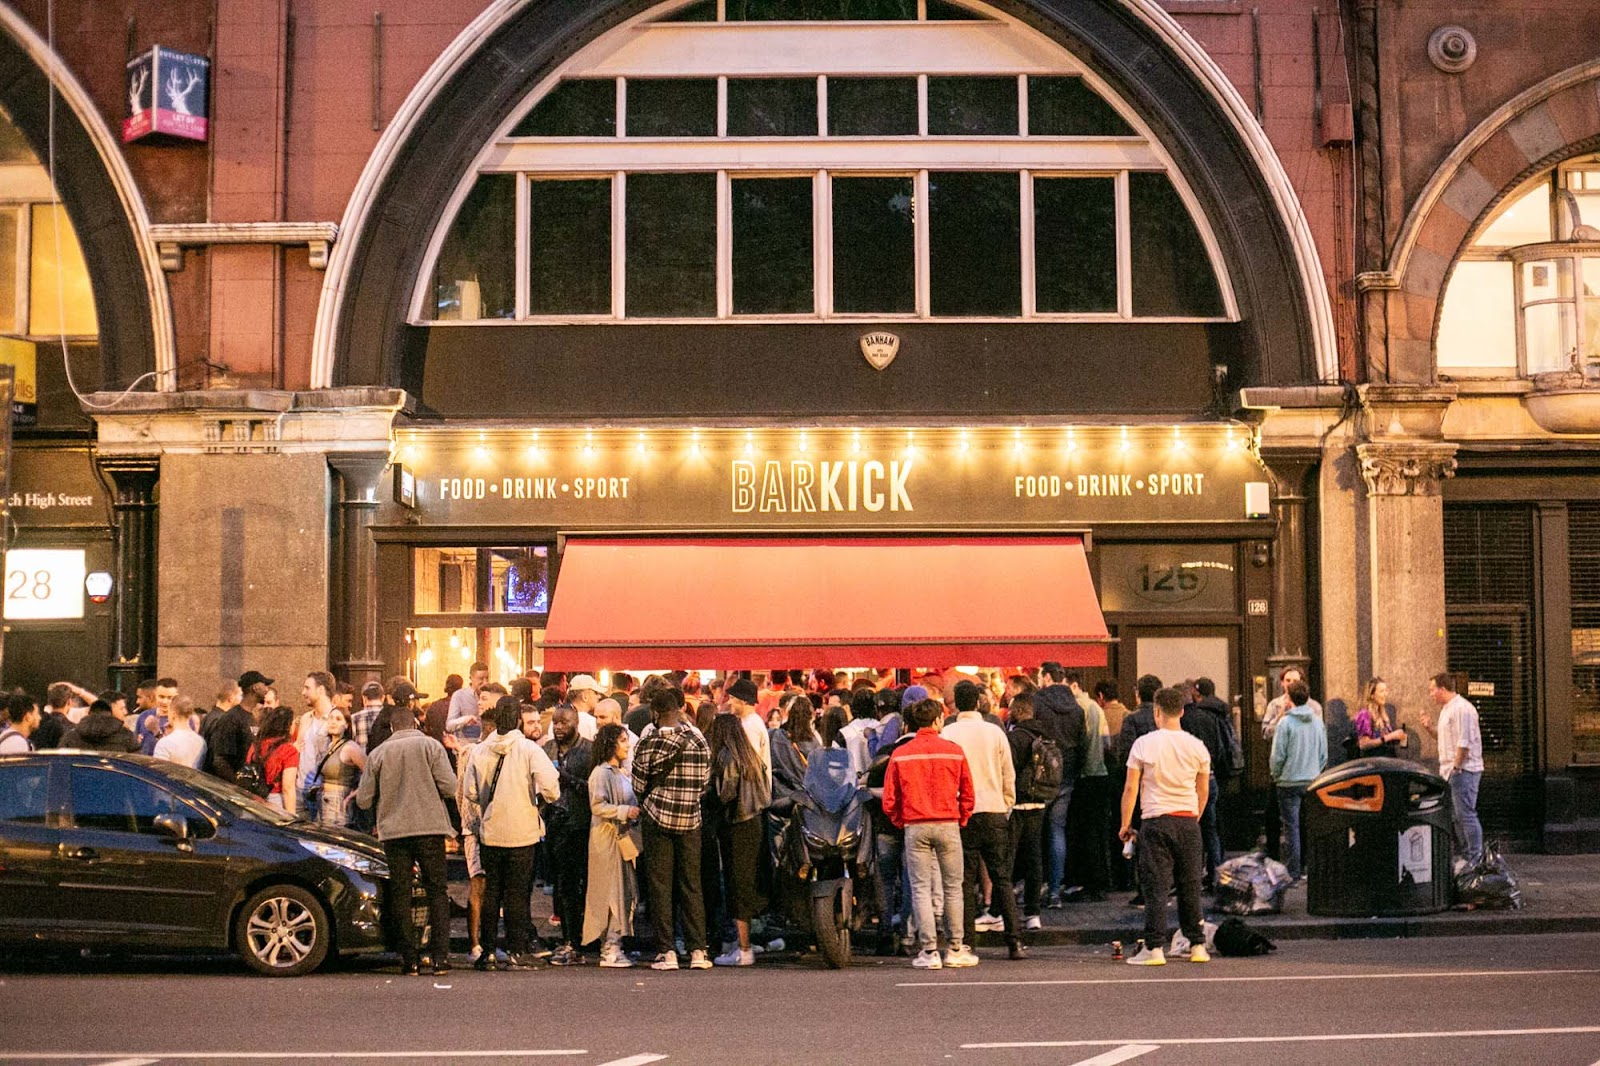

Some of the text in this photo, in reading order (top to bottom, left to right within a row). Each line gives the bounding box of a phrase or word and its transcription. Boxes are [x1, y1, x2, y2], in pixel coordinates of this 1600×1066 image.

[865, 335, 895, 347] BANHAM
[440, 477, 629, 499] FOOD DRINK SPORT
[732, 460, 914, 512] BARKICK
[1015, 473, 1204, 497] FOOD DRINK SPORT
[25, 493, 56, 509] High
[58, 493, 93, 506] Street
